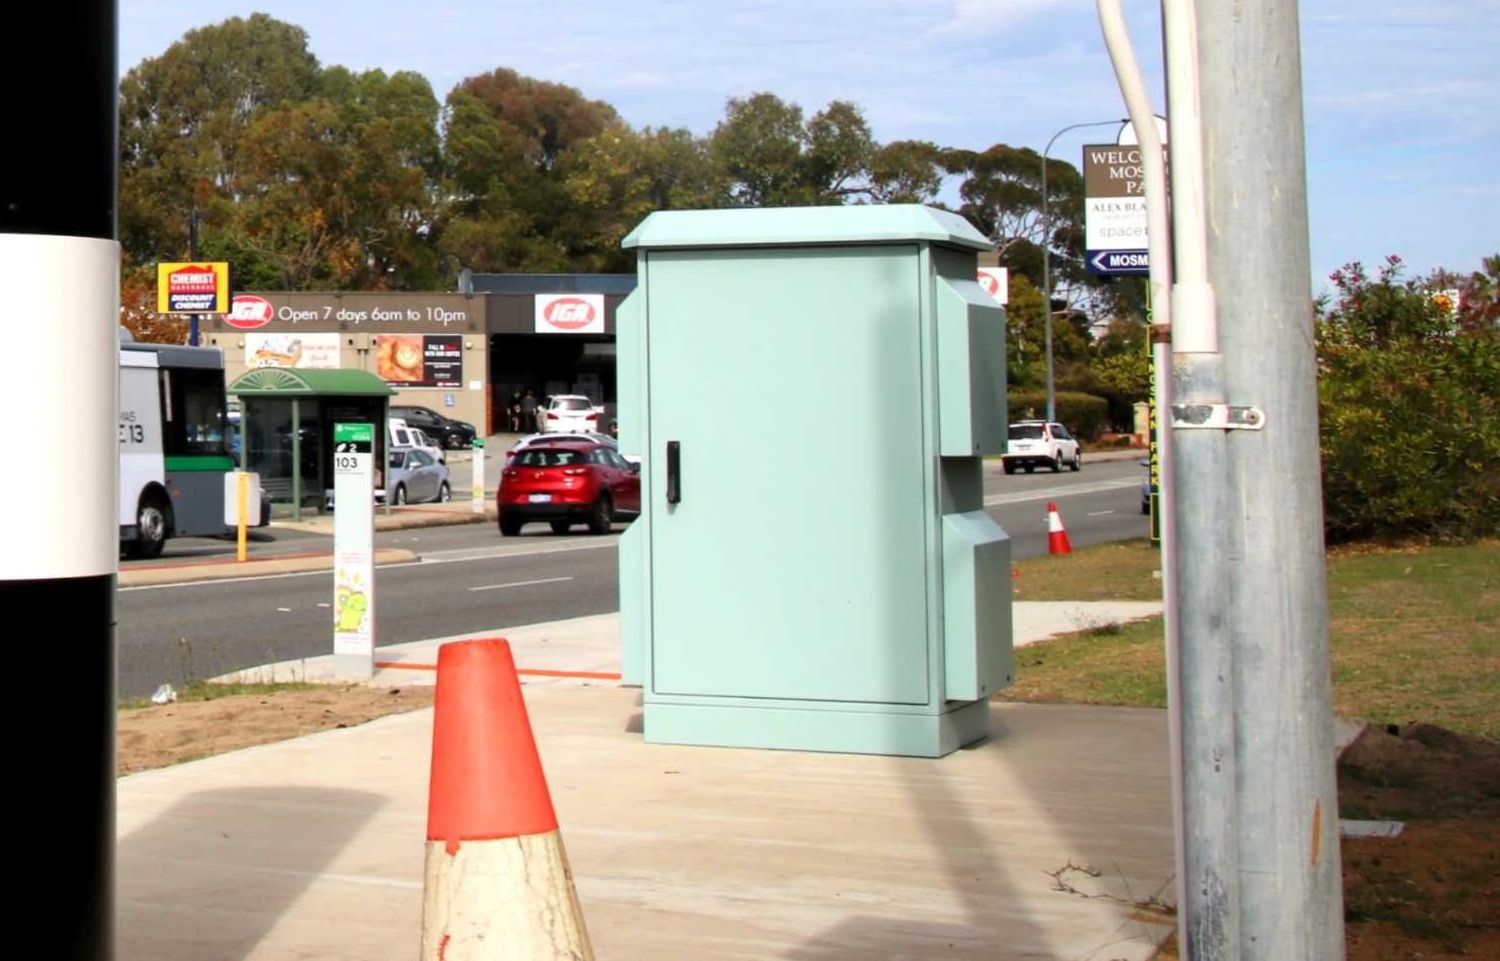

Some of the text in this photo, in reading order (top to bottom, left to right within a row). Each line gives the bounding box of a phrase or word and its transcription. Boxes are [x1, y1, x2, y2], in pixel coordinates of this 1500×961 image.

[1091, 150, 1143, 165] WELC
[1109, 166, 1145, 179] MOS
[1109, 254, 1149, 267] MOSM
[171, 273, 214, 284] CHEMIST
[171, 294, 215, 302] DISCOUNT
[228, 301, 268, 321] IGA
[278, 306, 466, 325] Open 7 days 6am to 10pm
[549, 303, 591, 322] IGA
[129, 424, 145, 443] 13
[349, 442, 357, 453] 2
[336, 457, 358, 469] 103
